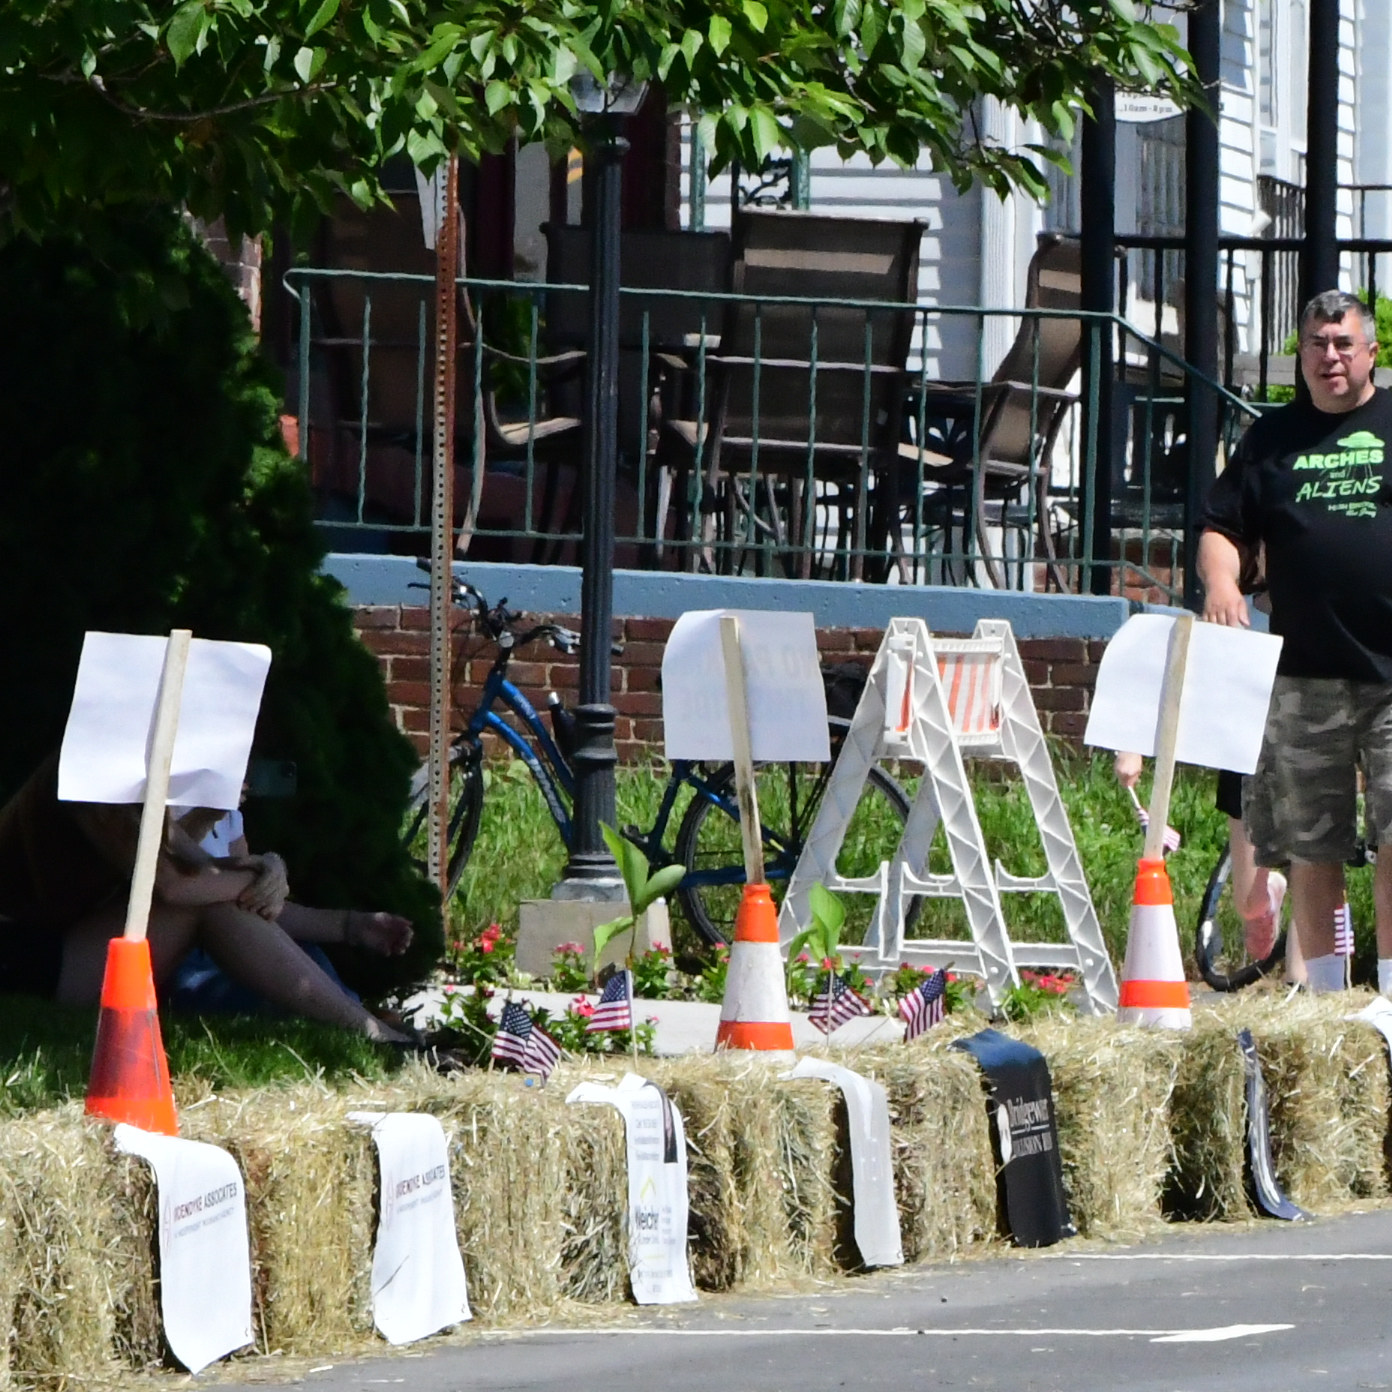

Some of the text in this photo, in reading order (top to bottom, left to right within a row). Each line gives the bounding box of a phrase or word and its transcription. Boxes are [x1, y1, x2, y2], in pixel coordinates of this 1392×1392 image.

[1293, 449, 1385, 470] ARCHES
[1329, 470, 1346, 479] and
[1295, 475, 1383, 503] ALIENS
